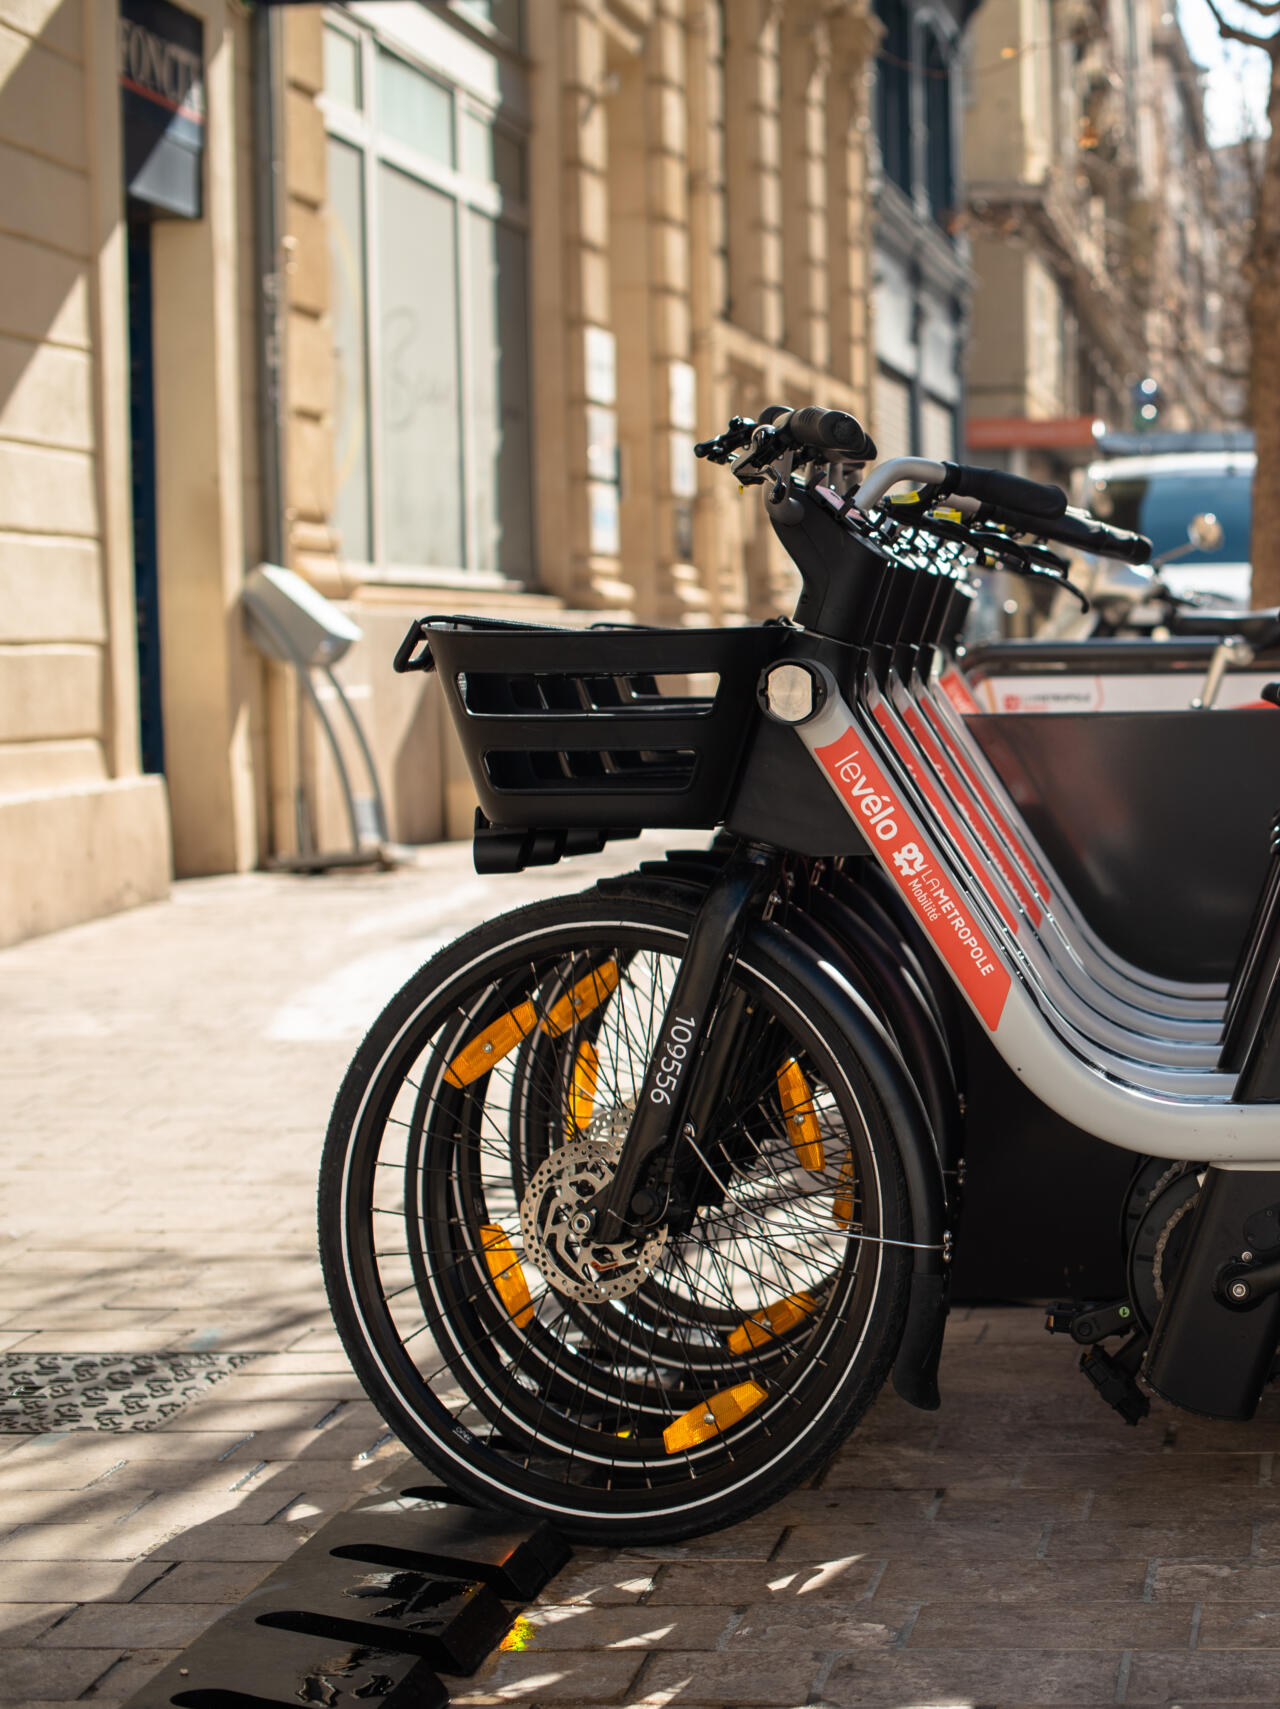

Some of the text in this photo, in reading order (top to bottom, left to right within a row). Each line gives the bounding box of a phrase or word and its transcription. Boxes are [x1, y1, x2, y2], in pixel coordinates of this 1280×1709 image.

[835, 751, 898, 841] levélo
[908, 878, 938, 922] Mobilité
[650, 1017, 696, 1105] 109556
